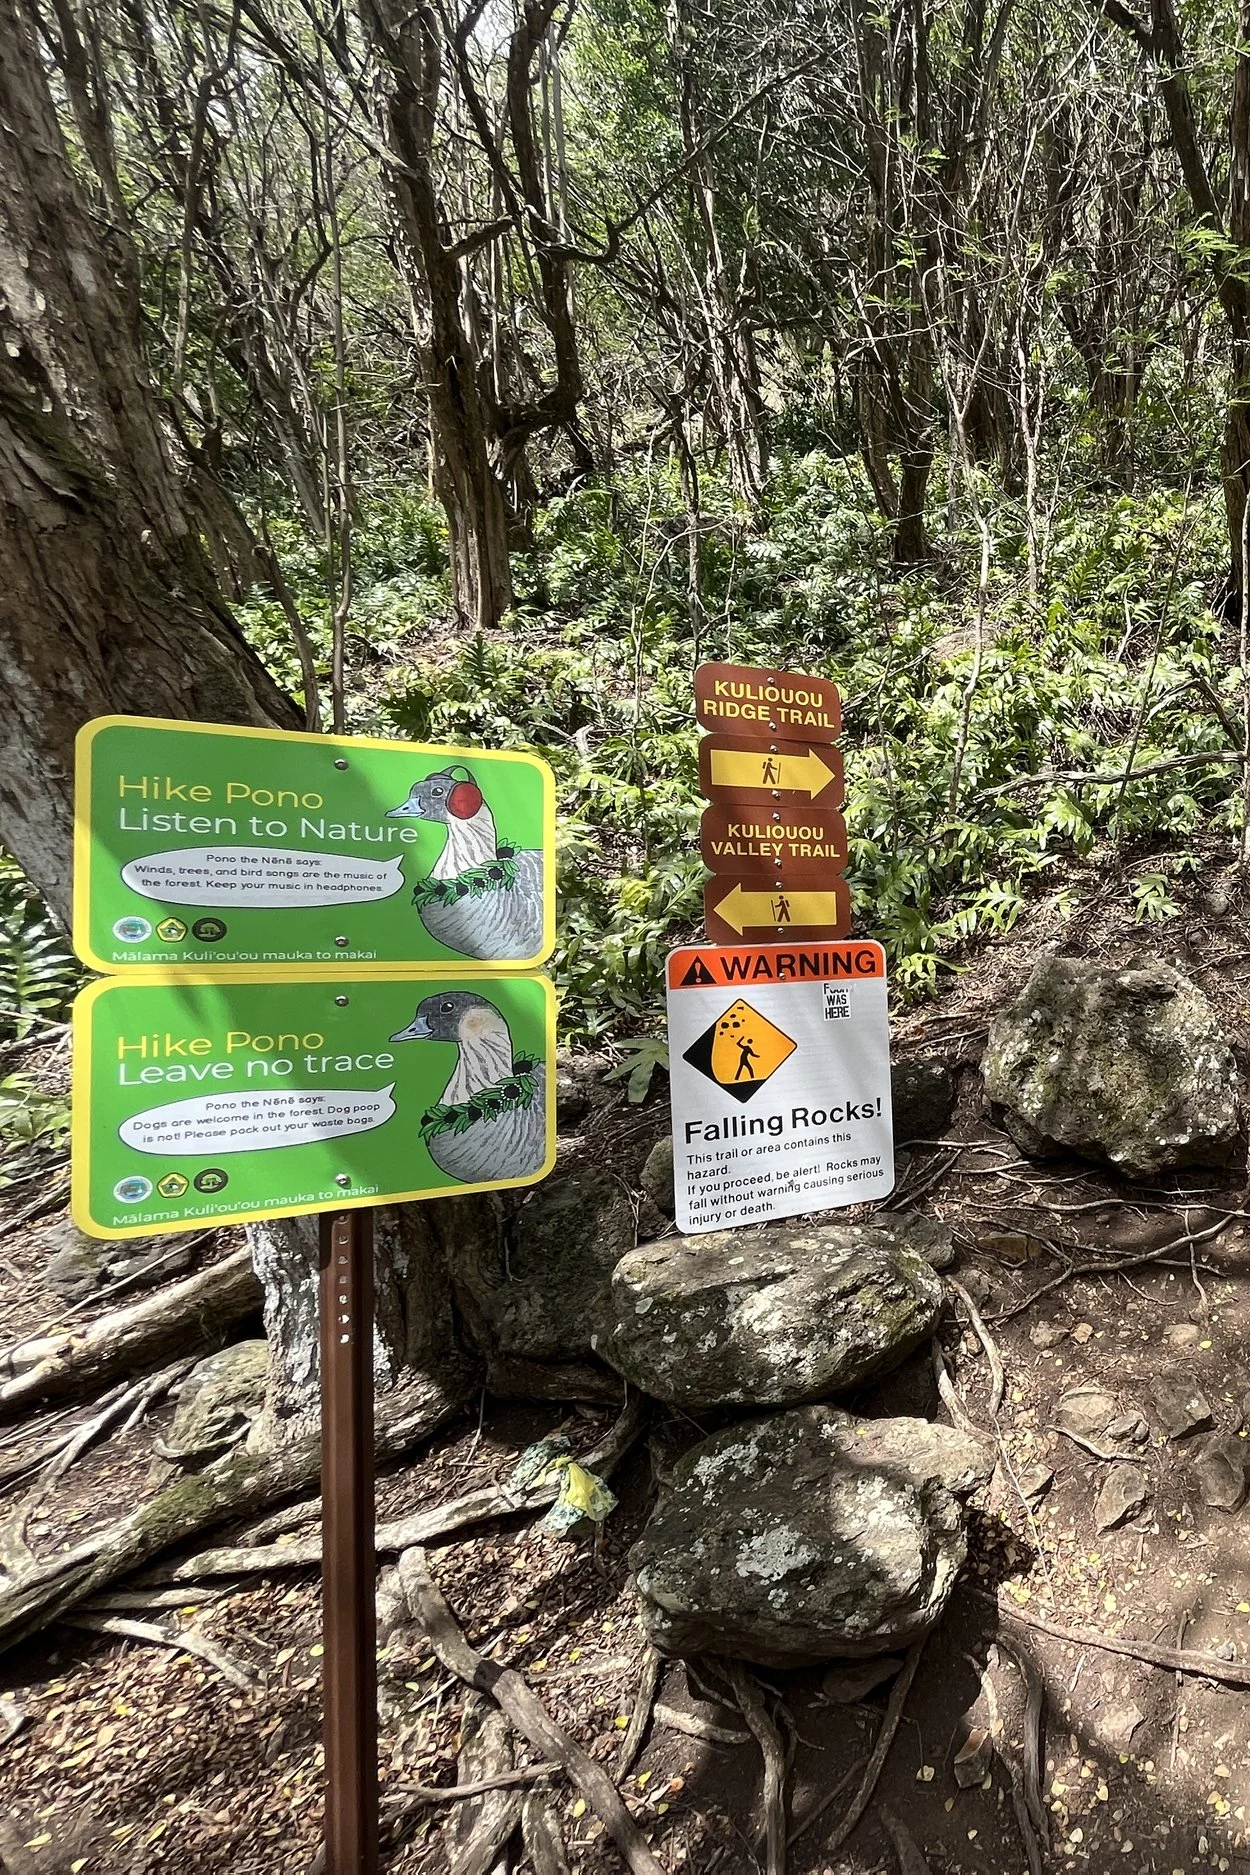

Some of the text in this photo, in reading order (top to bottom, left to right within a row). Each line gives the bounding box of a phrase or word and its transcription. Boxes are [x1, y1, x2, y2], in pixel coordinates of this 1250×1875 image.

[714, 680, 823, 708] KULIOUOU
[703, 699, 835, 729] RIDGE TRAIL
[119, 775, 324, 810] Hike Pono
[120, 807, 419, 843] Listen to Nature
[727, 823, 824, 841] KULIOUOU
[206, 854, 237, 863] Pono
[240, 856, 259, 864] the
[711, 841, 841, 859] VALLEY TRAIL
[134, 865, 176, 876] Winds,
[179, 866, 213, 877] trees,
[215, 868, 237, 876] and
[240, 868, 263, 877] bird
[266, 870, 299, 879] songs
[323, 871, 340, 879] the
[343, 872, 374, 880] music
[376, 872, 388, 880] of
[142, 879, 161, 887] the
[206, 880, 237, 890] Keep
[240, 881, 265, 891] your
[268, 882, 301, 890] music
[303, 882, 314, 890] in
[263, 950, 313, 960] mauka
[316, 950, 332, 960] to
[335, 949, 377, 960] makai
[719, 950, 877, 980] WARNING
[825, 1005, 850, 1019] HERE
[826, 994, 847, 1006] WAS
[118, 1031, 324, 1060] Hike Pono
[119, 1053, 395, 1086] Leave no trace
[133, 1121, 167, 1131] Dogs
[171, 1119, 192, 1127] are
[196, 1114, 250, 1125] welcome
[253, 1112, 263, 1120] in
[267, 1111, 286, 1119] the
[327, 1105, 351, 1115] Dog
[353, 1103, 380, 1114] poop
[205, 1102, 237, 1111] Pono
[241, 1100, 260, 1108] the
[143, 1134, 154, 1143] is
[184, 1129, 226, 1140] Please
[229, 1125, 259, 1137] pack
[262, 1124, 281, 1132] out
[284, 1121, 308, 1133] your
[312, 1118, 344, 1128] waste
[684, 1097, 882, 1145] Falling Rocks!
[687, 1132, 852, 1165] This trail or area contains this
[687, 1165, 731, 1181] hazard.
[687, 1155, 882, 1196] If you proceed, be alert! Rocks may
[264, 1193, 315, 1207] mauka
[318, 1191, 334, 1200] to
[336, 1184, 379, 1197] makai
[689, 1169, 885, 1210] fall without warning causing serious
[688, 1201, 776, 1226] injury or death.
